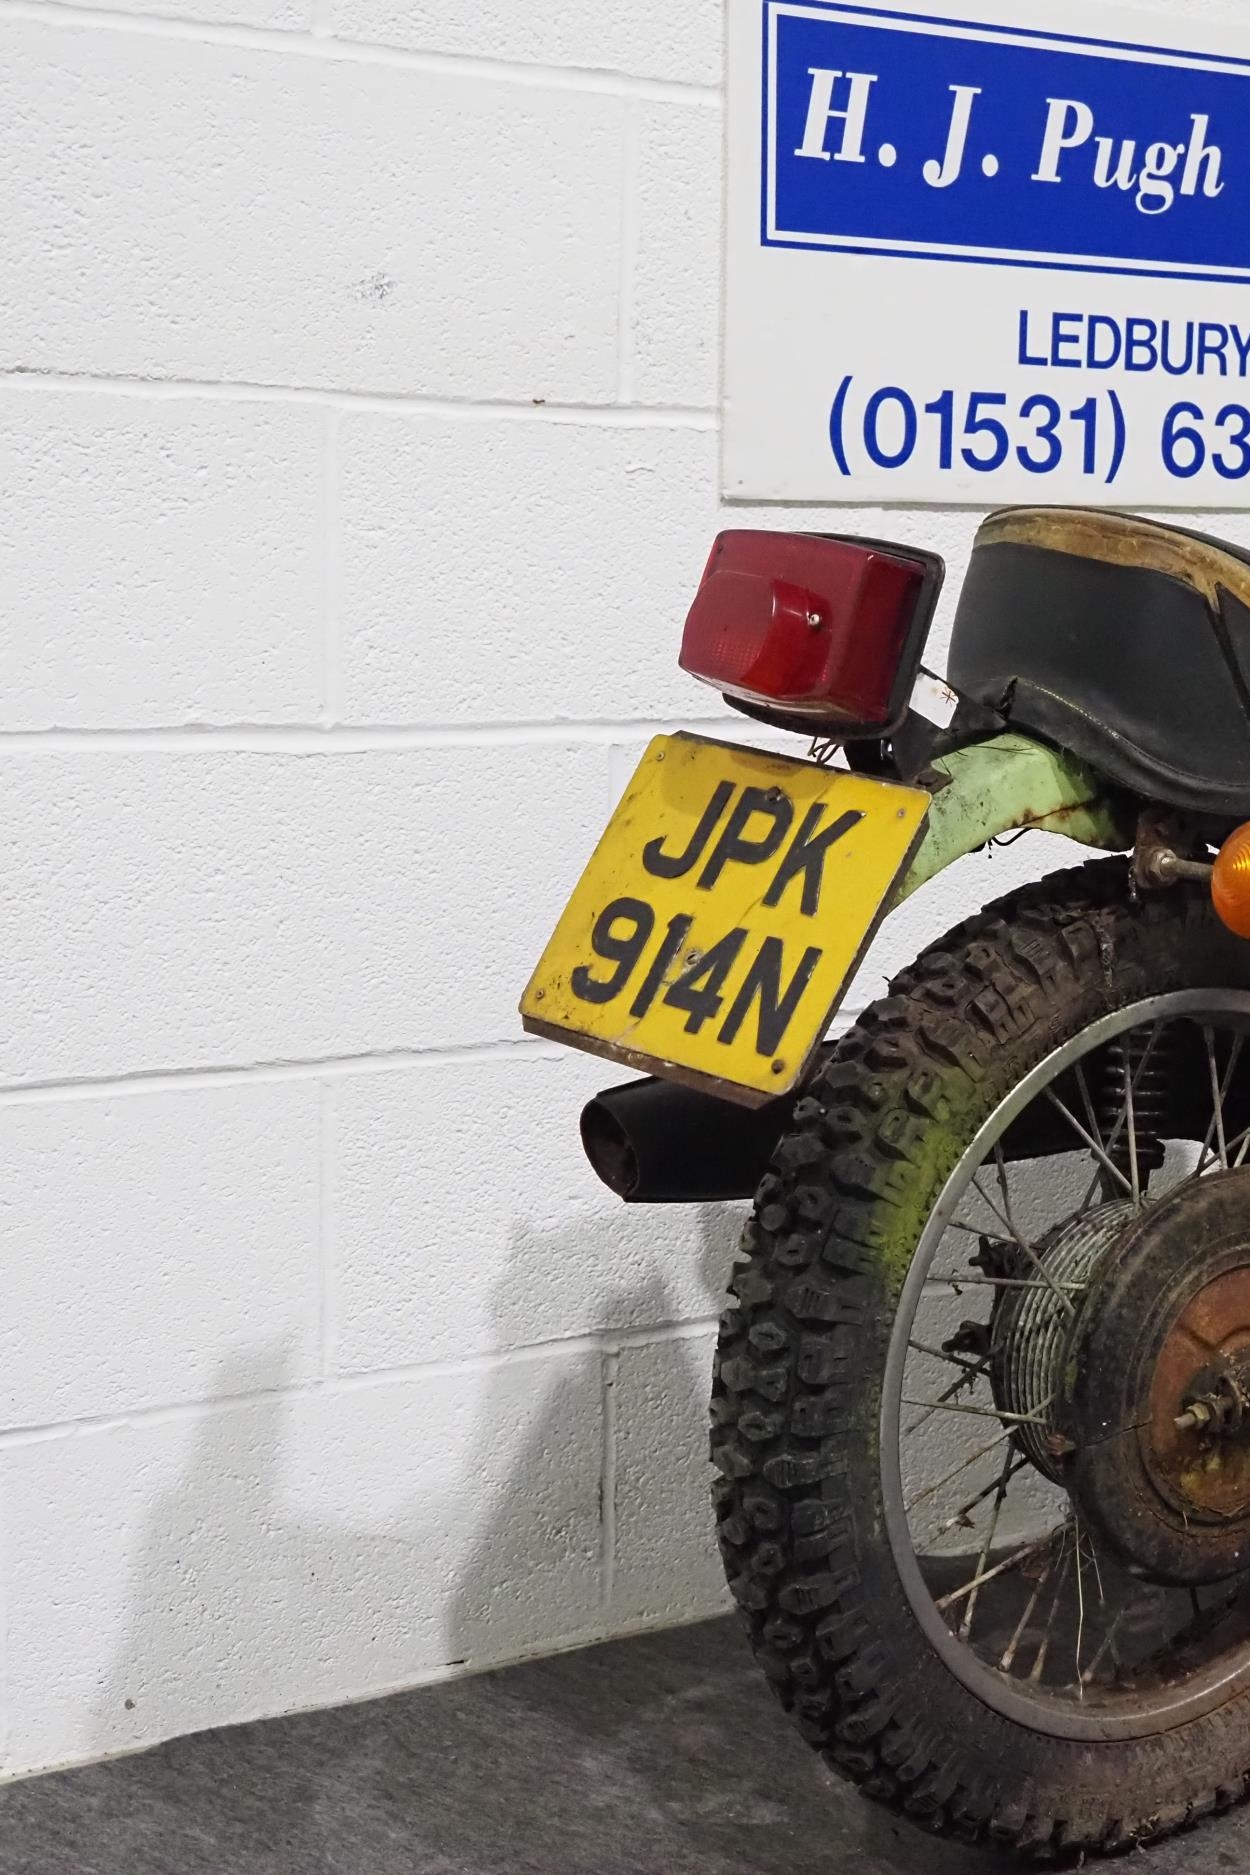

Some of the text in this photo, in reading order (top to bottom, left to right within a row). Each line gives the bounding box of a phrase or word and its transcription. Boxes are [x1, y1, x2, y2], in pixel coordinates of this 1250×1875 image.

[793, 67, 897, 167] H.
[922, 84, 999, 188] J.
[1031, 97, 1225, 215] Pugh
[829, 375, 1126, 484] (01531)
[642, 780, 864, 917] JPK
[571, 896, 823, 1057] 914N
